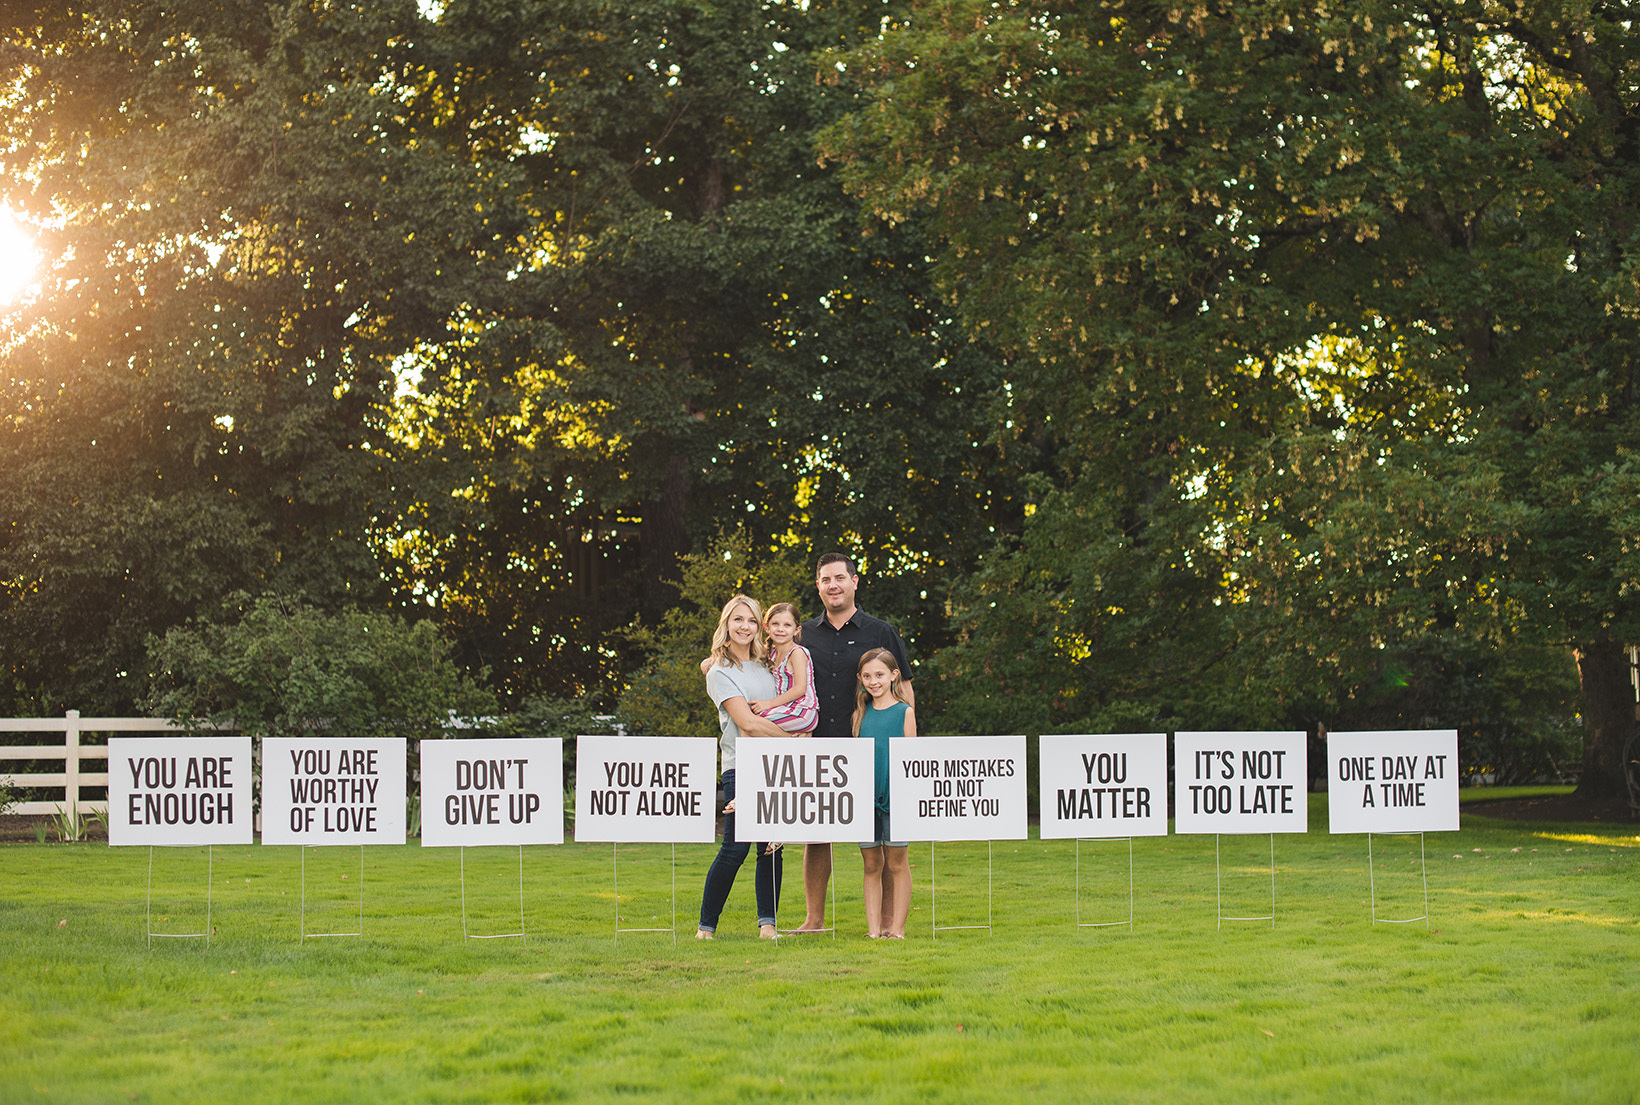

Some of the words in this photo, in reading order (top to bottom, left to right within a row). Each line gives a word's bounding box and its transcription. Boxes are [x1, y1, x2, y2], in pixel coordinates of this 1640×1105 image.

[128, 758, 176, 789] YOU
[185, 757, 233, 788] ARE
[290, 750, 330, 775] YOU
[338, 750, 378, 774] ARE
[457, 760, 528, 790] DON'T
[604, 762, 643, 787] YOU
[650, 763, 689, 788] ARE
[762, 755, 848, 788] VALES
[903, 760, 939, 778] YOUR
[944, 759, 1014, 777] MISTAKES
[1082, 753, 1126, 784] YOU
[1196, 751, 1234, 779] IT'S
[1243, 751, 1286, 779] NOT
[1339, 757, 1375, 781] ONE
[1382, 756, 1417, 780] DAY
[1425, 755, 1446, 779] AT
[290, 779, 379, 803] WORTHY
[934, 780, 951, 797] DO
[957, 779, 984, 797] NOT
[1189, 785, 1231, 814] TOO
[1240, 785, 1293, 813] LATE
[1363, 784, 1375, 807] A
[1380, 783, 1425, 807] TIME
[129, 793, 233, 825] ENOUGH
[446, 794, 500, 825] GIVE
[509, 794, 539, 824] UP
[591, 791, 630, 815] NOT
[636, 791, 701, 816] ALONE
[757, 792, 853, 824] MUCHO
[919, 800, 967, 817] DEFINE
[972, 799, 999, 816] YOU
[1058, 788, 1150, 819] MATTER
[291, 807, 315, 832] OF
[325, 807, 377, 832] LOVE
